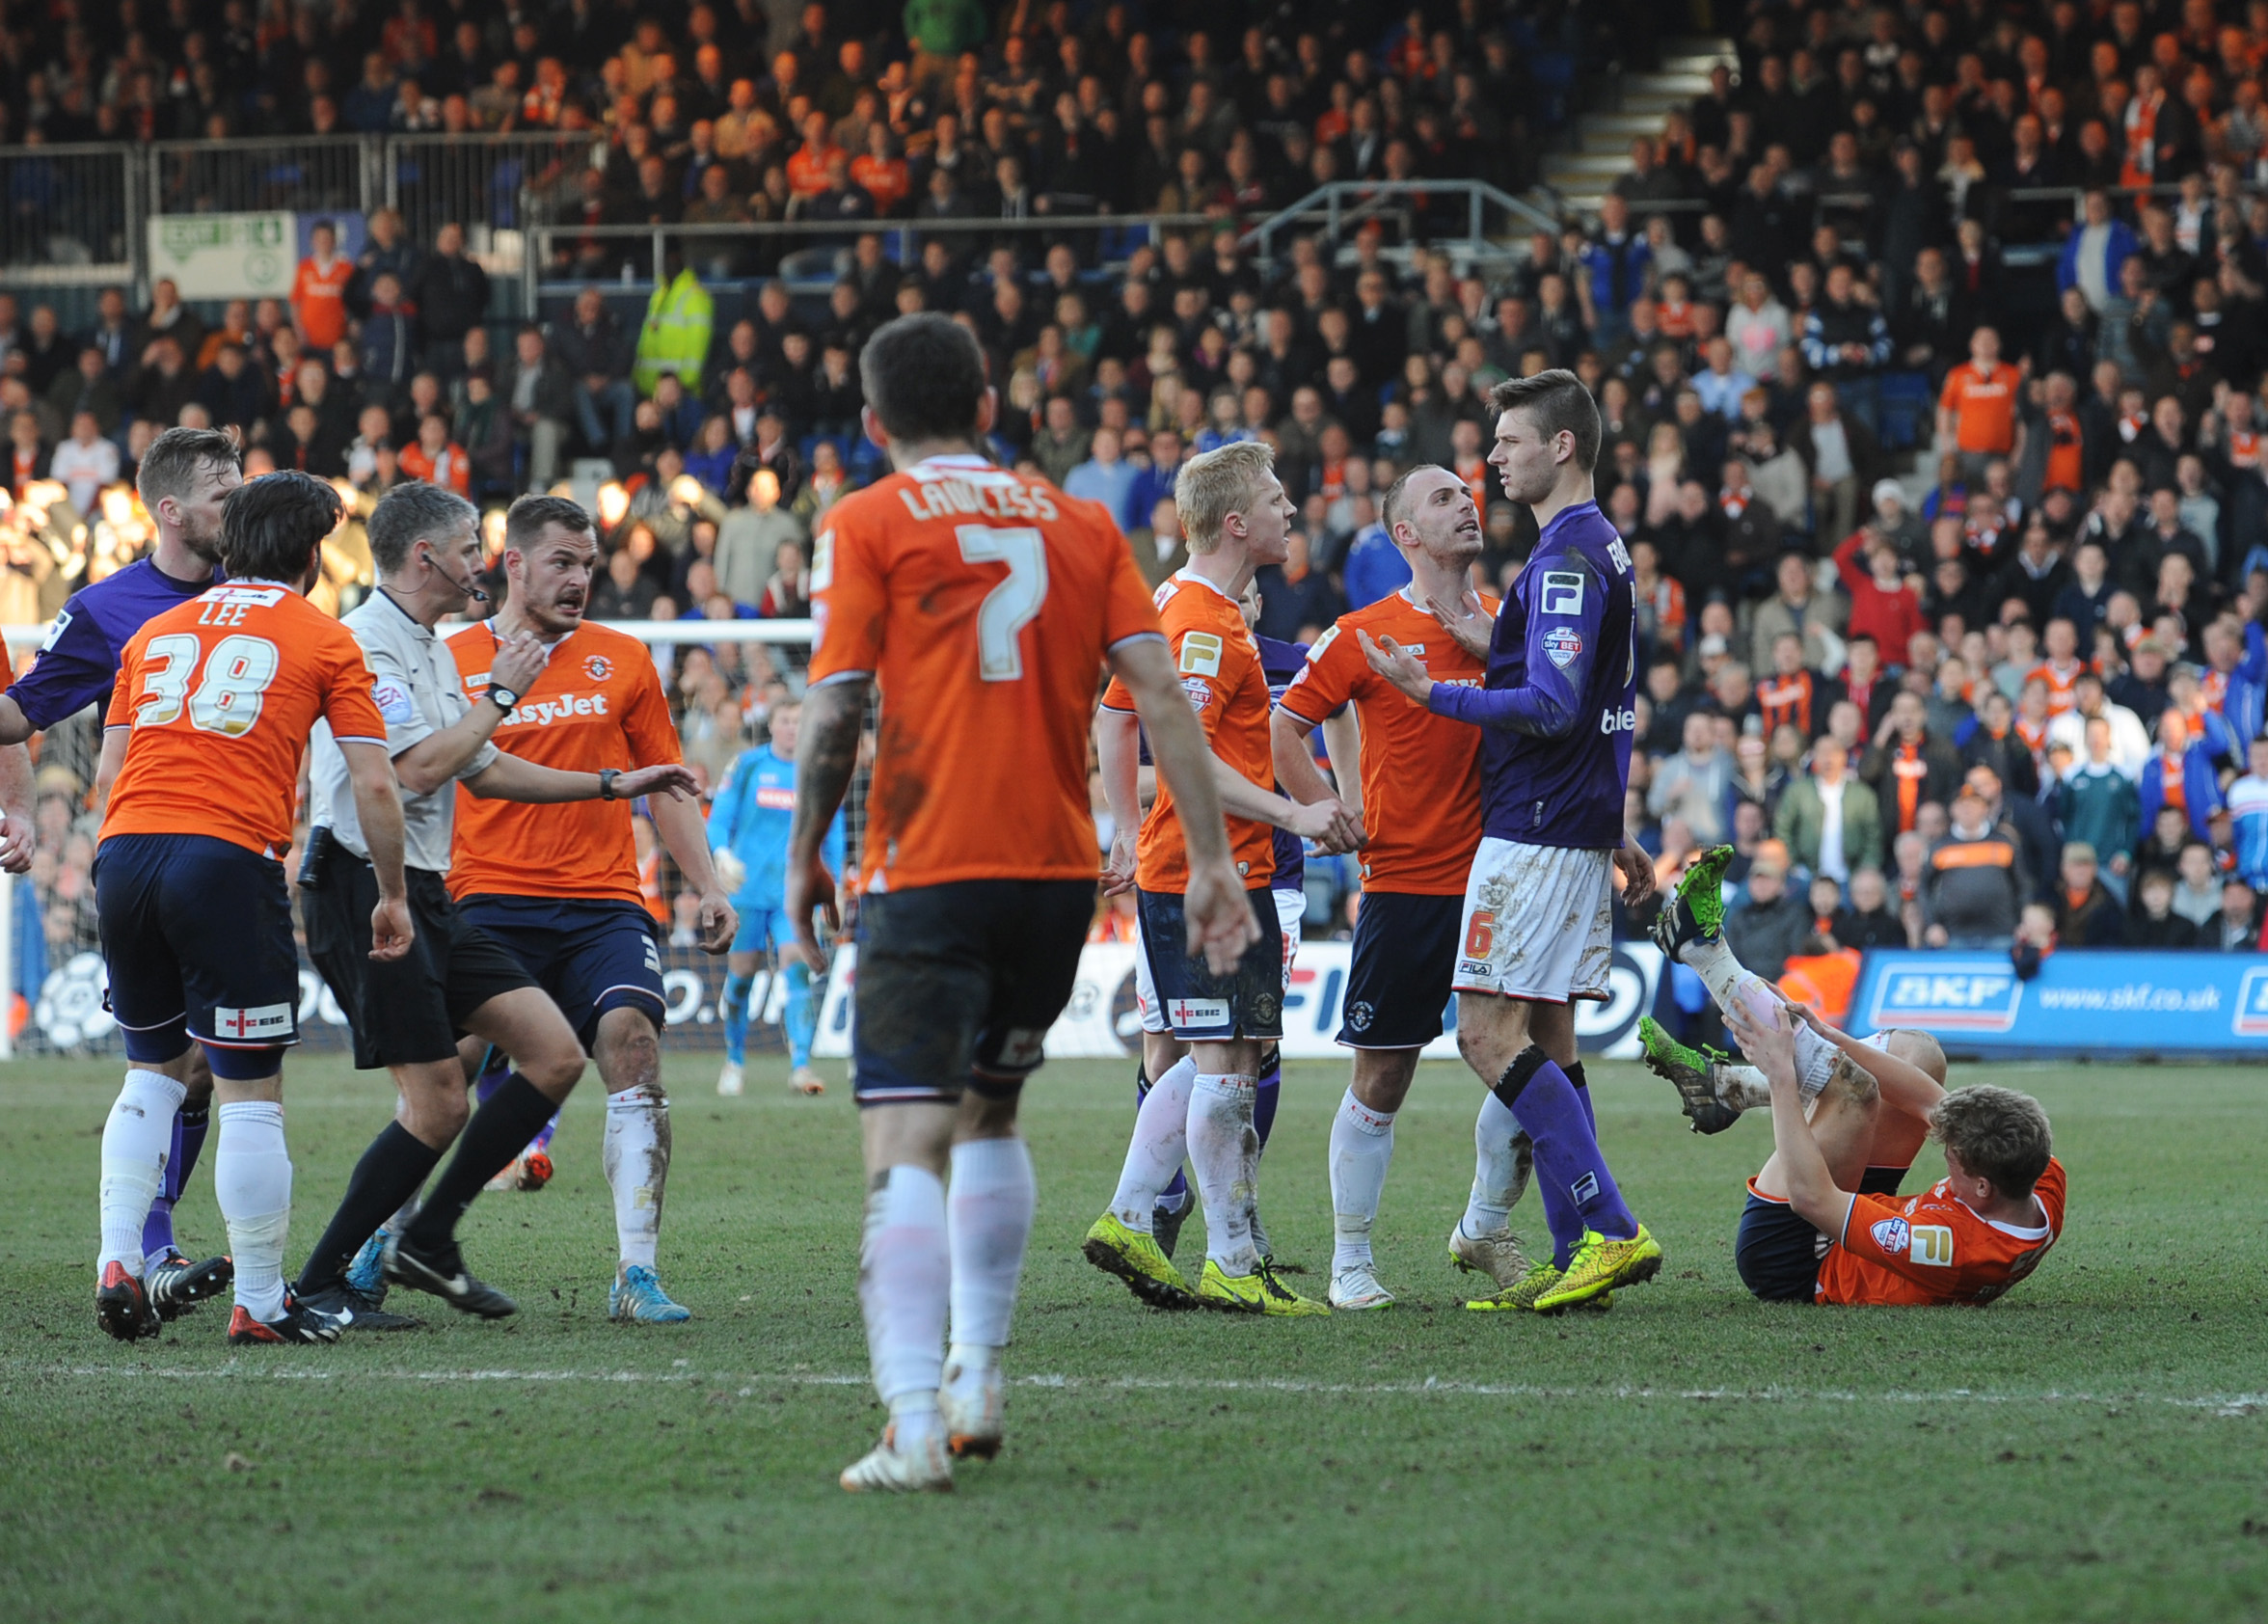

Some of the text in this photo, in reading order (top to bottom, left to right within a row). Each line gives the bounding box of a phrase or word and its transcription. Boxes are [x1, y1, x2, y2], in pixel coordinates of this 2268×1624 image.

[198, 603, 251, 626] LEE
[954, 524, 1049, 682] 7
[1560, 641, 1580, 651] BET
[135, 633, 280, 739] 38
[499, 693, 608, 726] asyJet
[1465, 911, 1494, 960] 6
[1462, 962, 1487, 974] FILA
[1891, 974, 2011, 1008] SKF
[2038, 982, 2222, 1012] www.skf.co.uk
